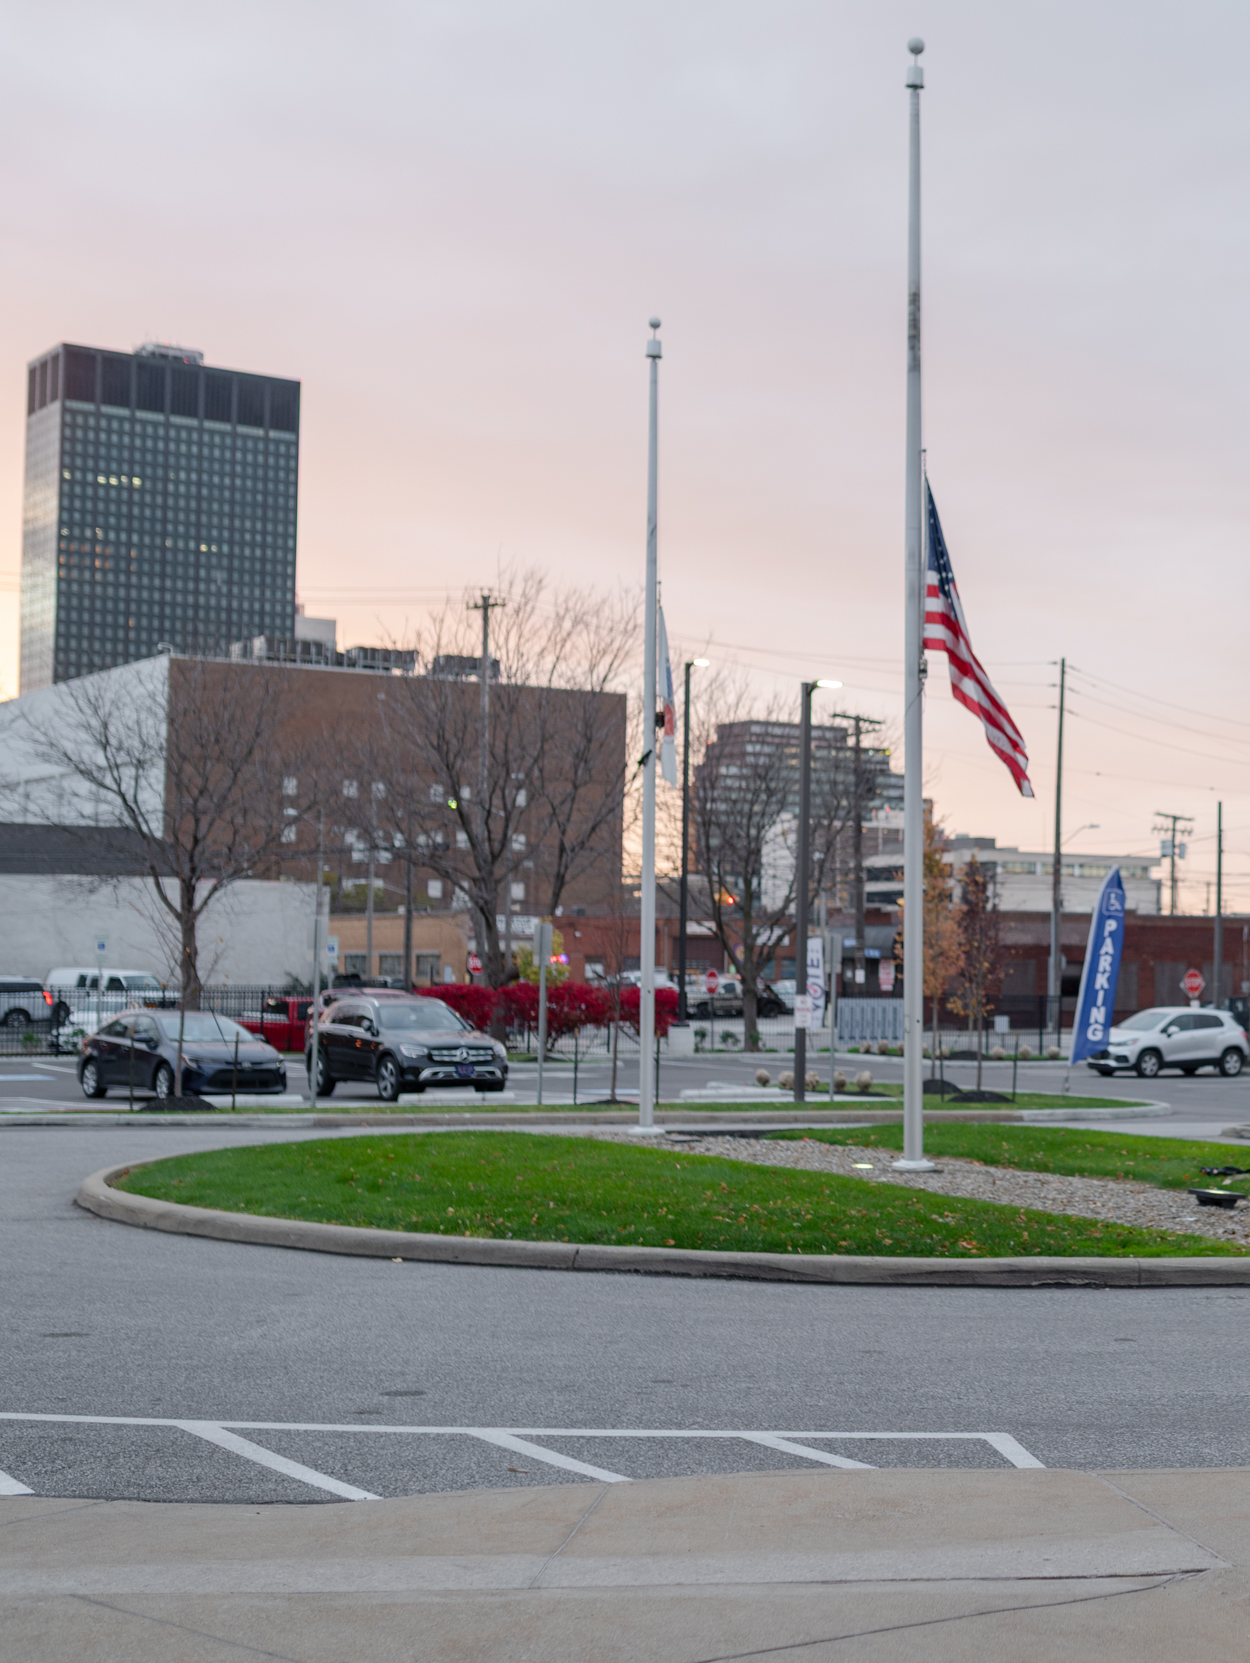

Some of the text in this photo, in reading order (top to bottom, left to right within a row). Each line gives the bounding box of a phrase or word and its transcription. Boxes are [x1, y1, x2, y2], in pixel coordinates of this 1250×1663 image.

[468, 956, 482, 968] STO
[807, 958, 824, 1012] VOTE
[1087, 919, 1118, 1041] PARKING
[1185, 977, 1202, 987] STOP
